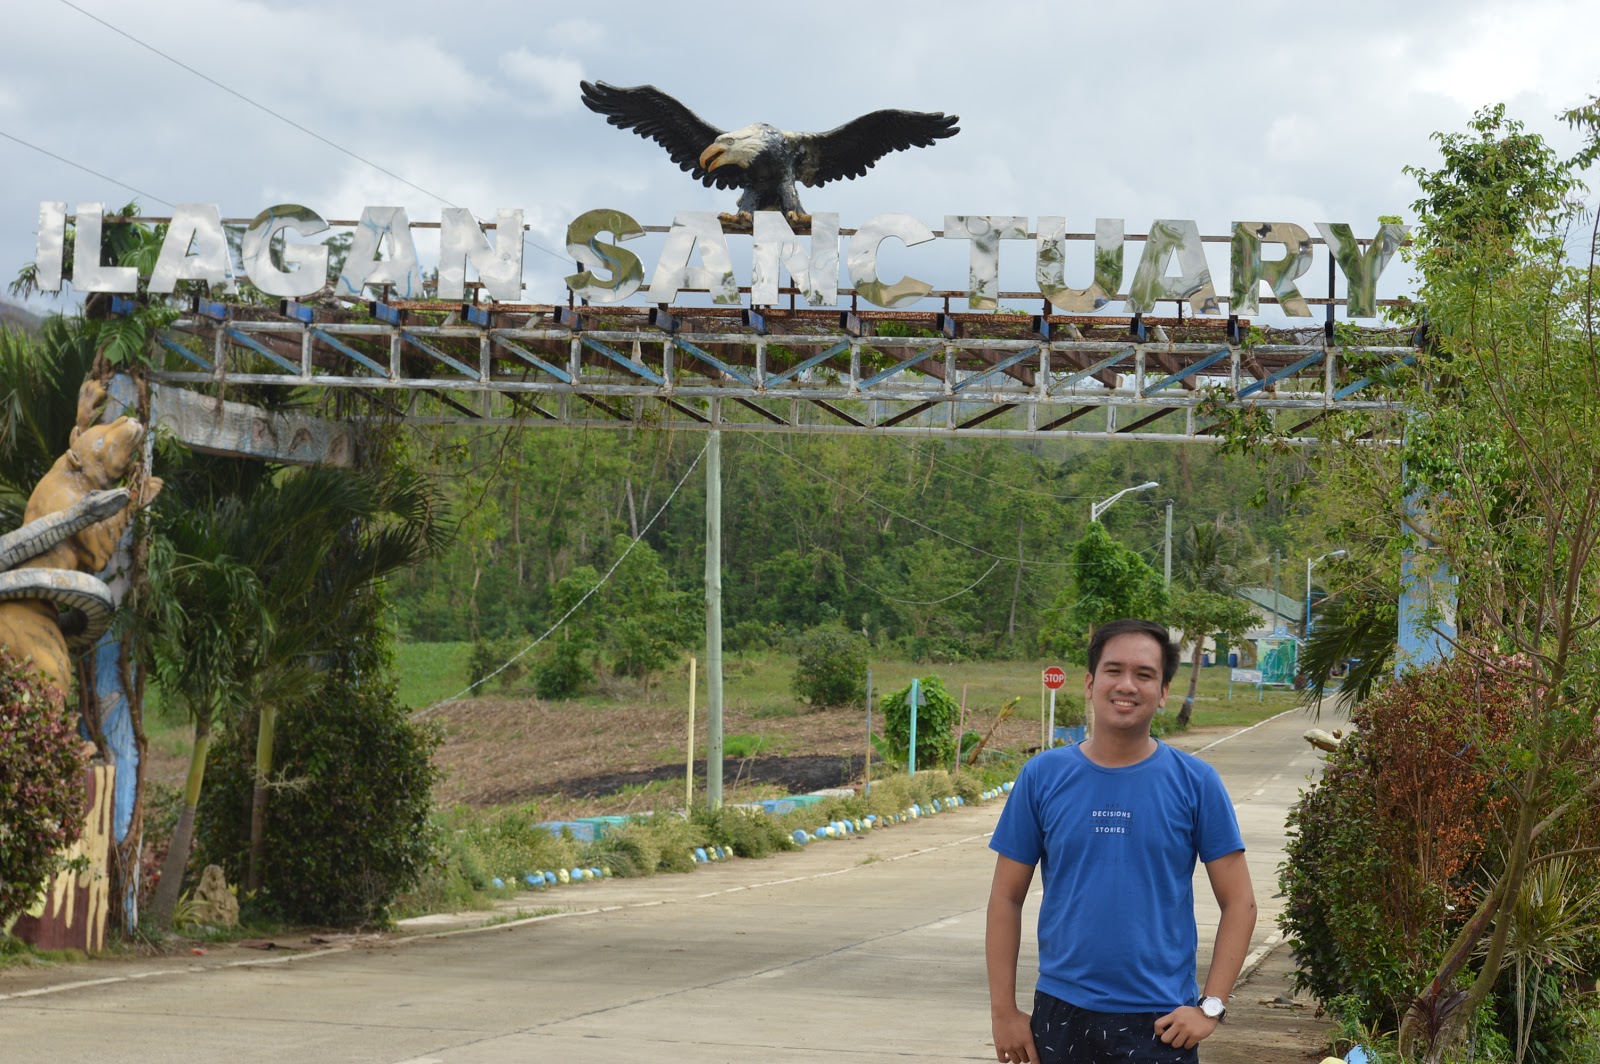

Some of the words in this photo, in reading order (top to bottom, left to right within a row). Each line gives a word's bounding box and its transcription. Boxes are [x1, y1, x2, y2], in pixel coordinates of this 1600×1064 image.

[36, 201, 525, 300] ILAGAN
[564, 208, 1412, 318] SANCTUARY
[1044, 673, 1064, 683] STOP
[1092, 810, 1131, 818] DECISIONS
[1095, 826, 1125, 834] STORIES
